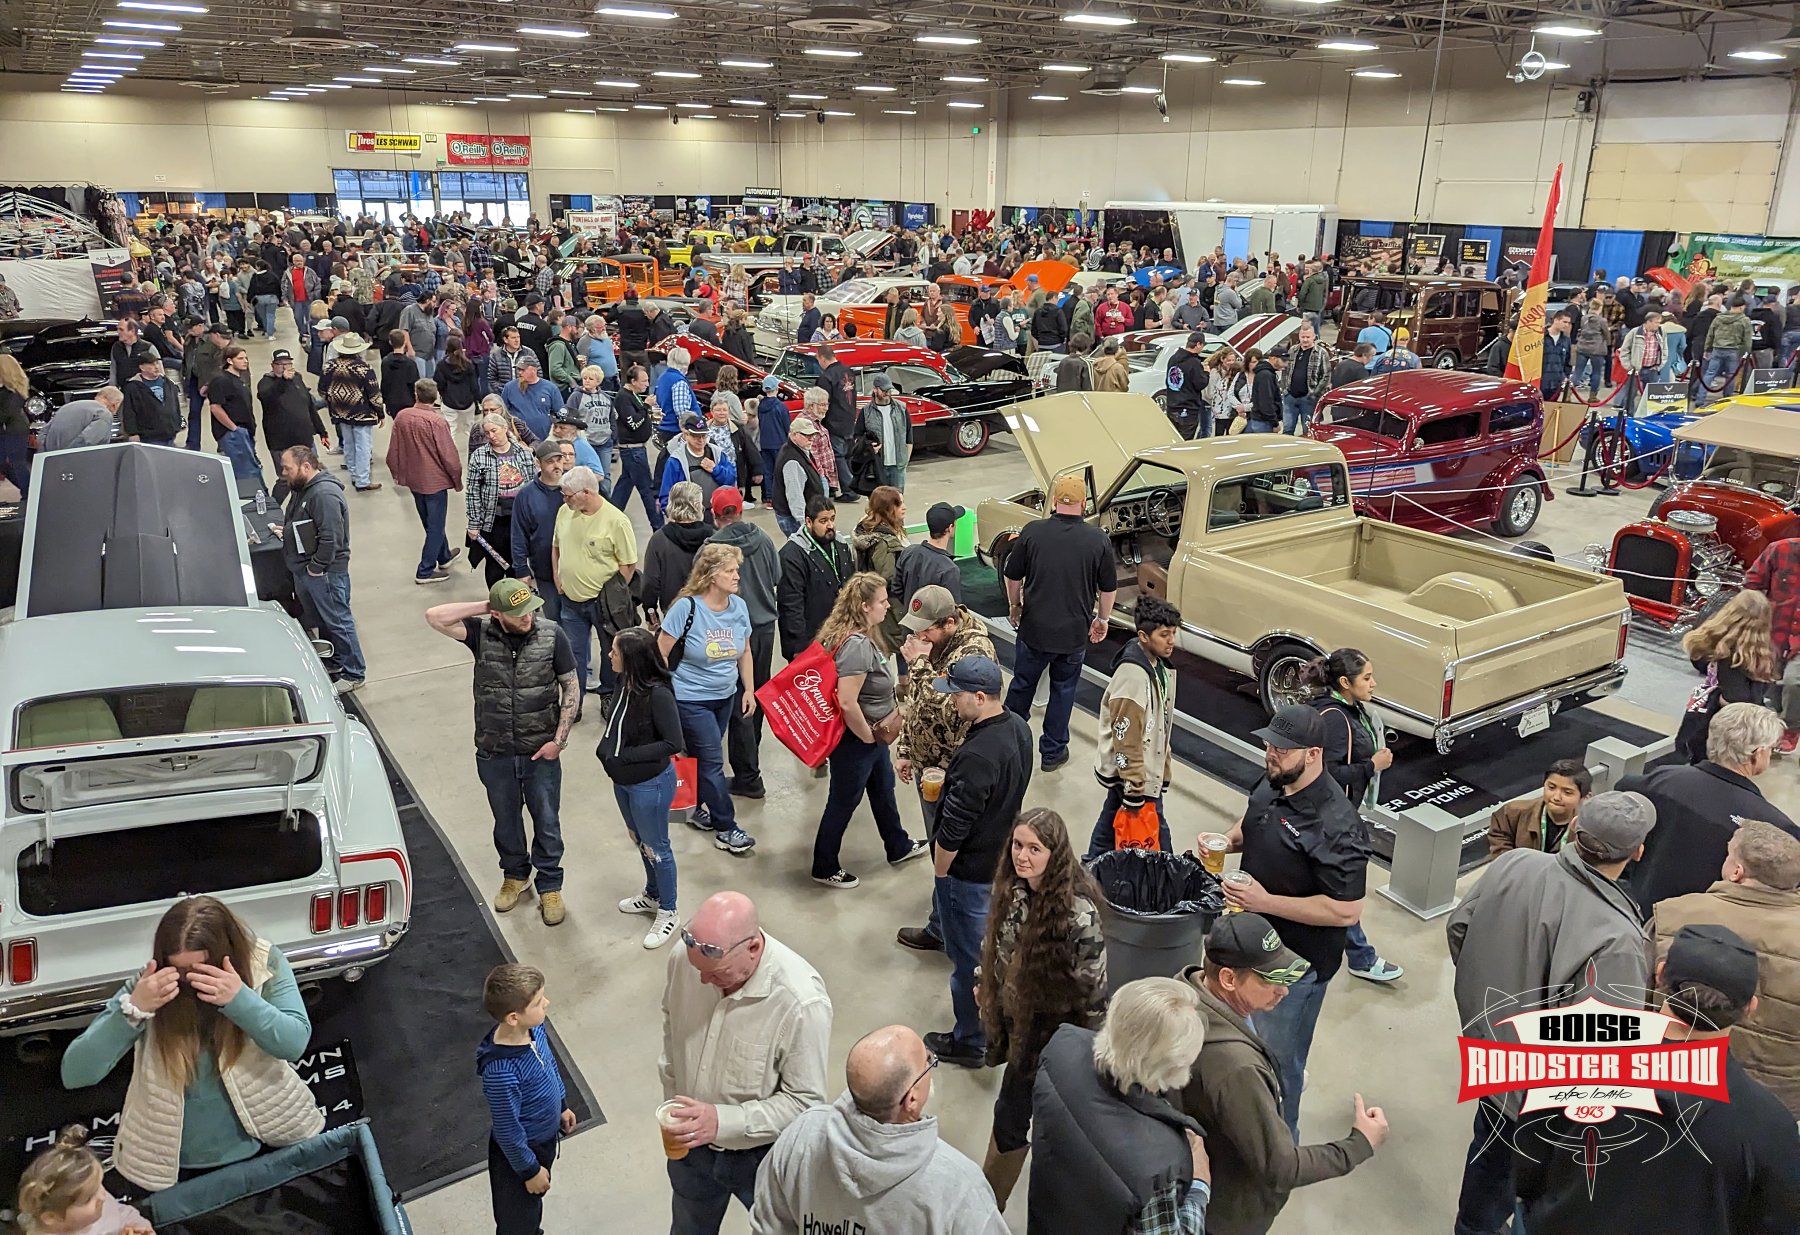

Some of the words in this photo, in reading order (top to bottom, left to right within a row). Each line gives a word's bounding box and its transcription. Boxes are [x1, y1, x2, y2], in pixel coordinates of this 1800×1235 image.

[357, 134, 374, 145] Tires
[376, 136, 388, 146] LES
[389, 138, 418, 147] SCHWAB
[452, 141, 488, 156] O'Reilly
[492, 142, 528, 157] O'Reilly
[517, 321, 537, 331] SECURITY
[1726, 477, 1744, 486] DODGE
[706, 628, 734, 640] Angel
[1404, 777, 1457, 800] DOWN
[1427, 785, 1474, 805] TOMS
[803, 1212, 850, 1235] Howell
